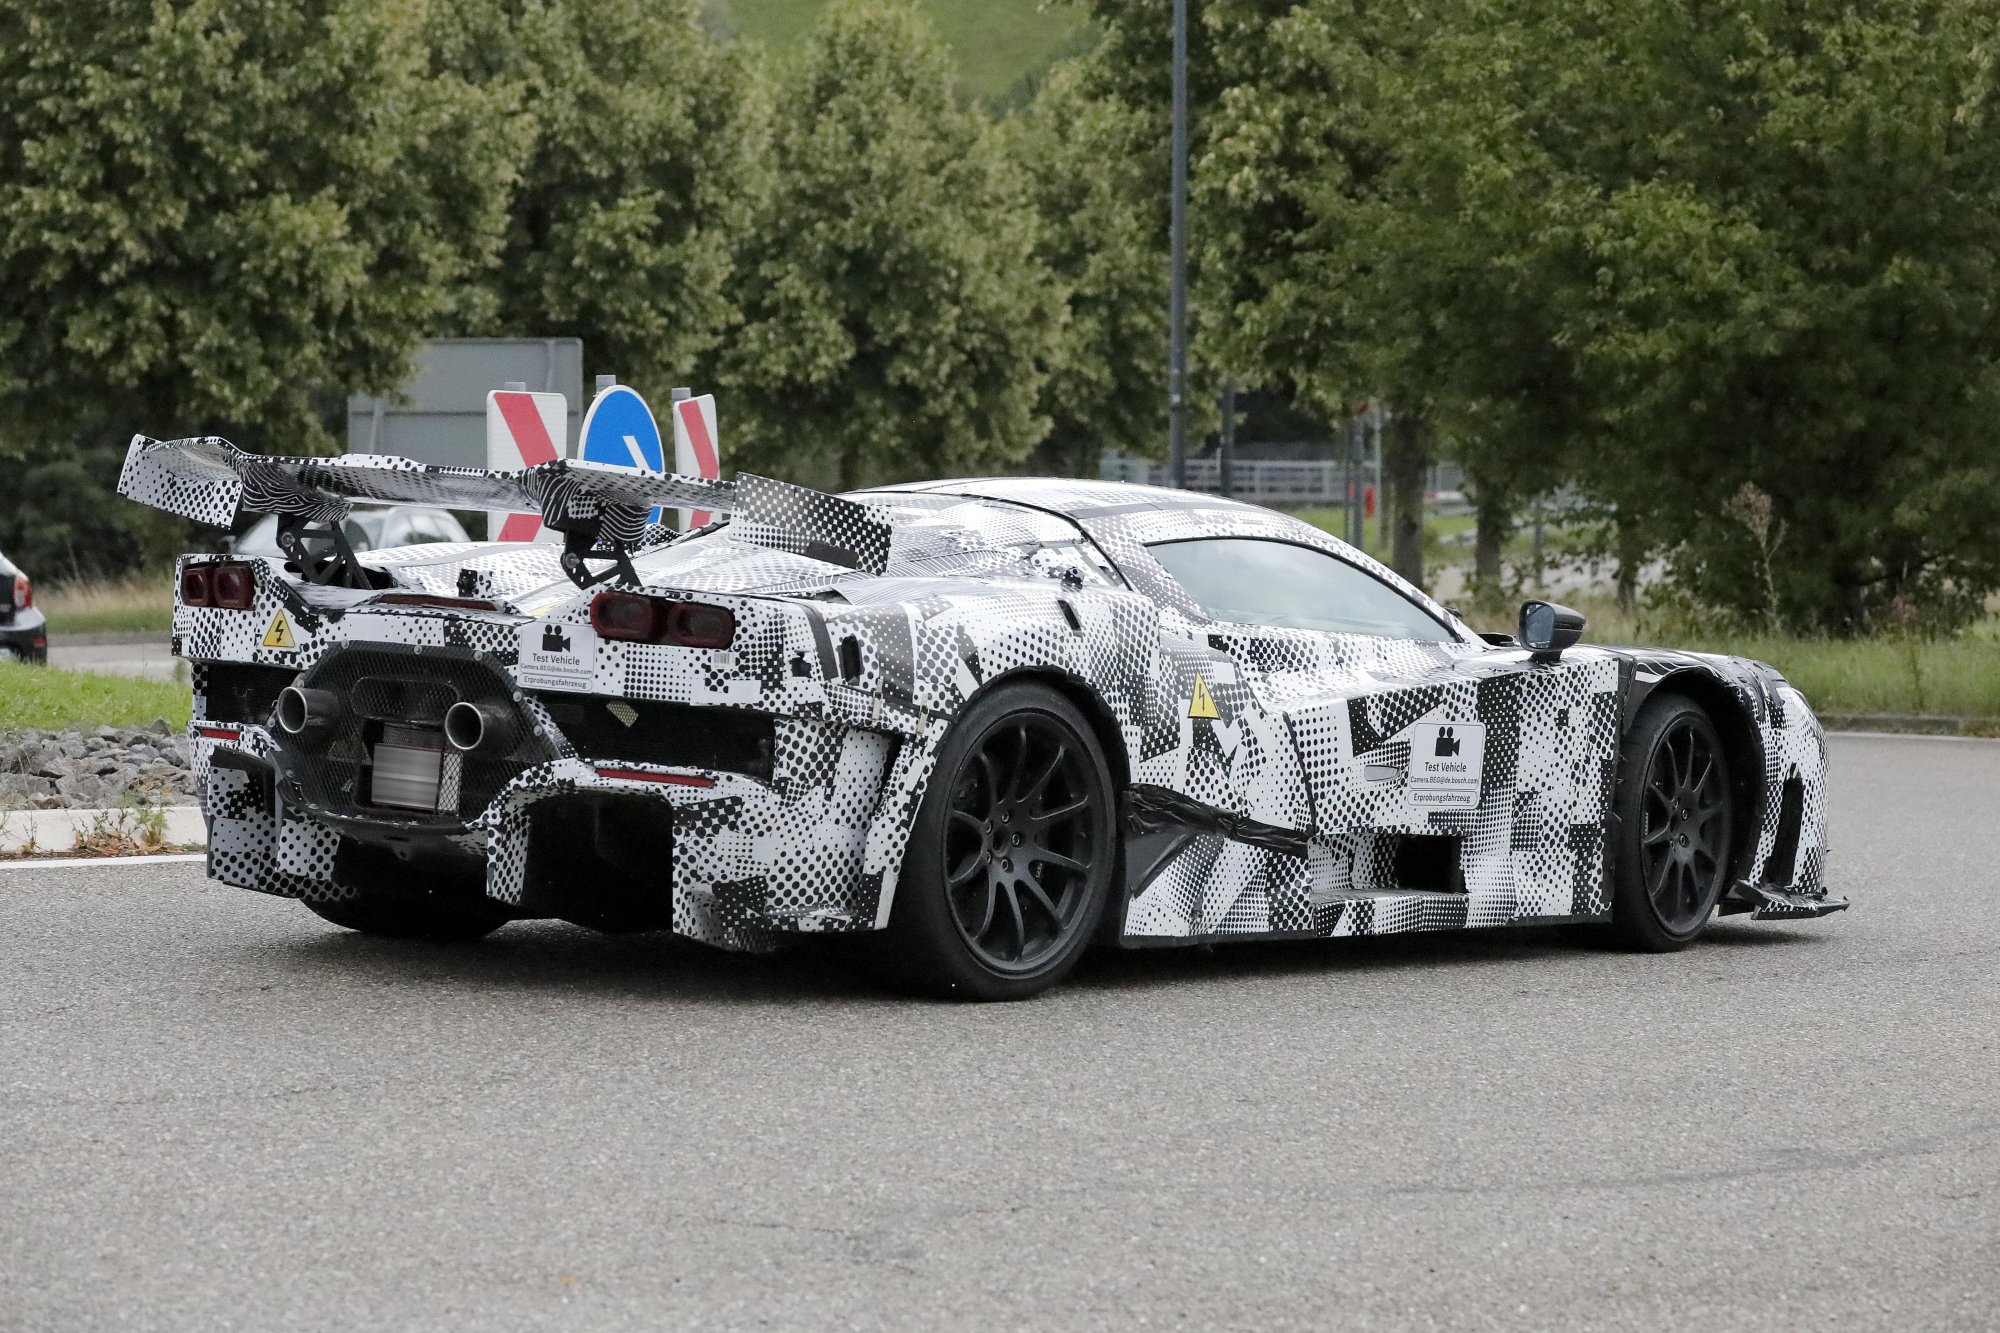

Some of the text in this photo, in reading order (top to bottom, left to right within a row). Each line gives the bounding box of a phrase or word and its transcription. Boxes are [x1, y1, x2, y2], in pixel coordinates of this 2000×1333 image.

[533, 653, 580, 665] Test Vehicle
[523, 675, 587, 689] Erprobungsfahrzeug
[1425, 762, 1467, 772] Test Vehicle
[1413, 793, 1471, 803] Erprobungsfahrzeug
